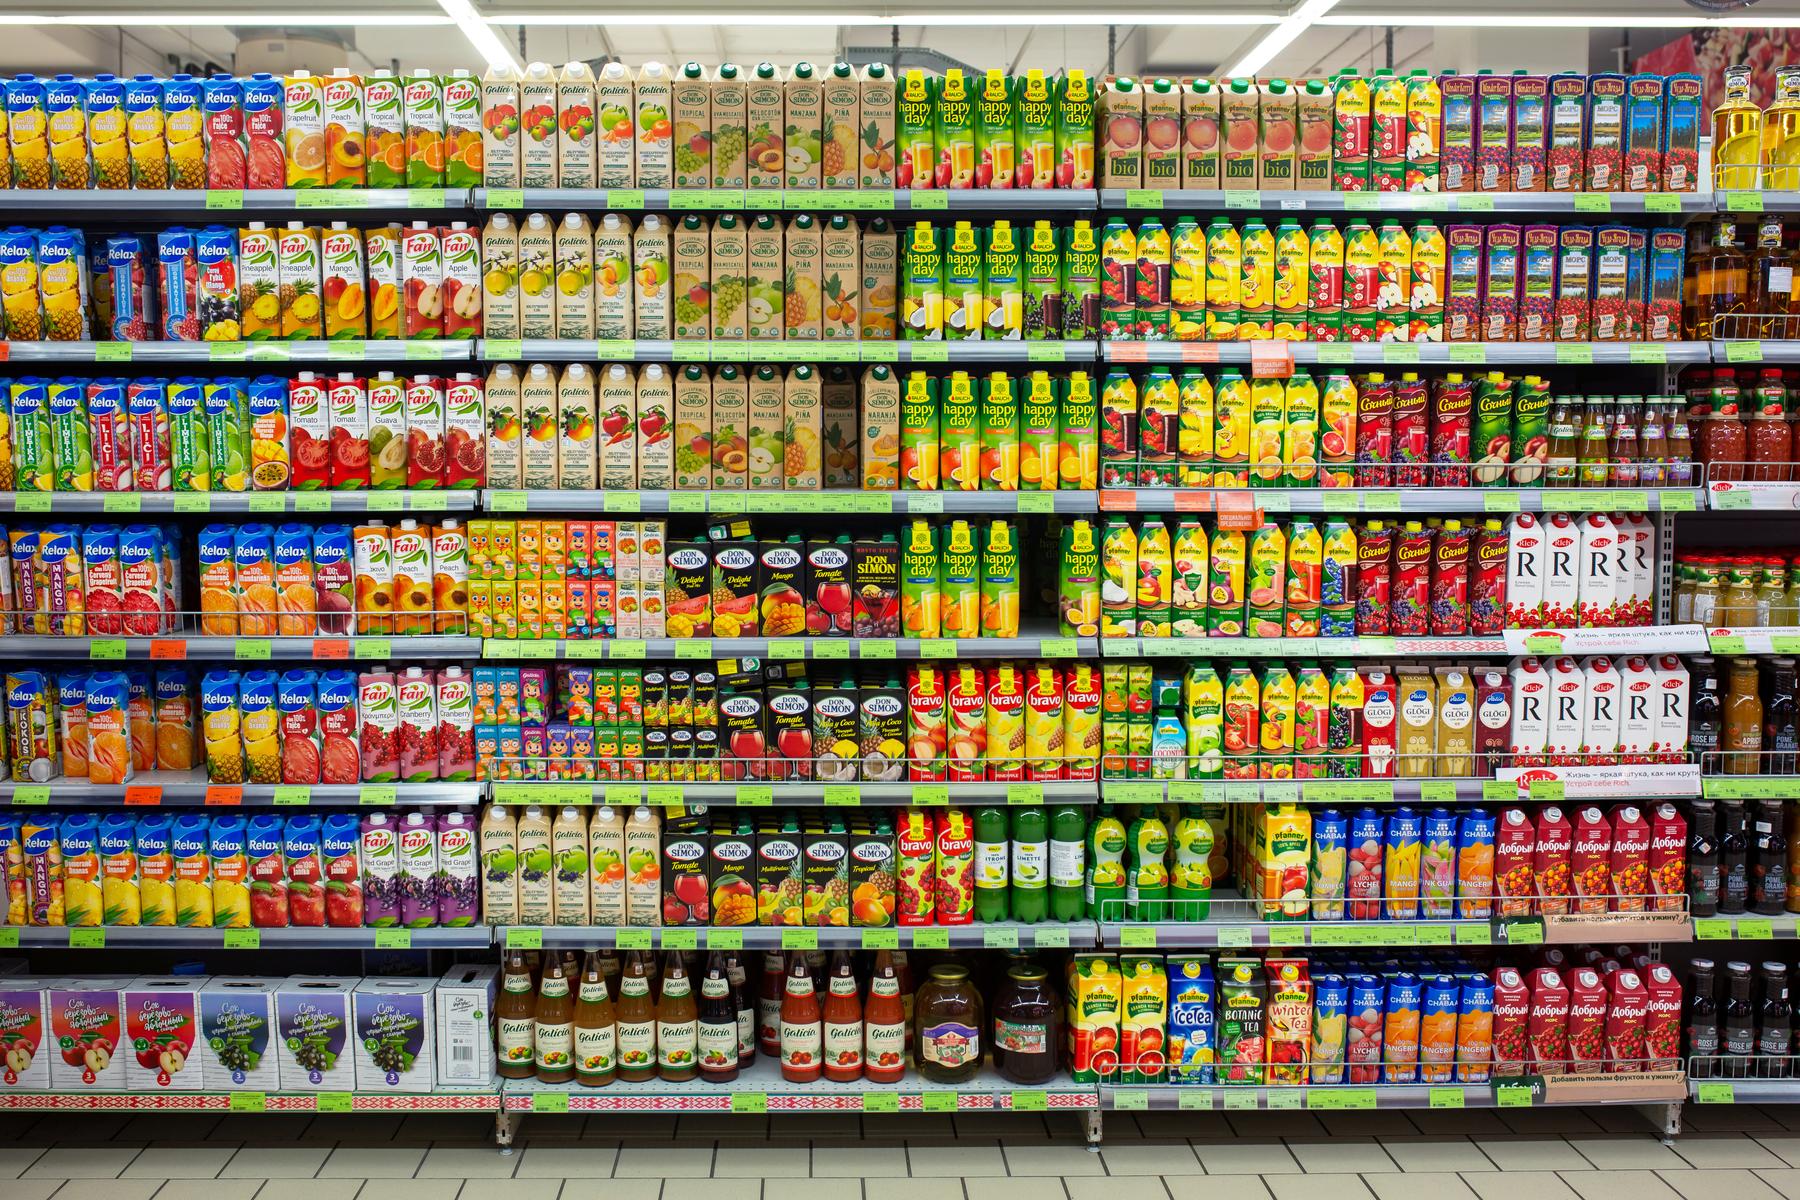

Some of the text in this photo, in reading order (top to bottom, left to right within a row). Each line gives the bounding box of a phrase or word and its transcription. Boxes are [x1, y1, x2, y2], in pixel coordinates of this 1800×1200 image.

[327, 86, 349, 100] Fan
[407, 86, 431, 100] Fan
[486, 86, 514, 95] Galicia
[639, 86, 669, 95] Galicia
[48, 93, 77, 104] Relax
[207, 93, 237, 103] Relax
[899, 101, 931, 114] happy
[1019, 101, 1052, 114] happy
[1341, 100, 1363, 108] pfanner
[371, 113, 394, 122] Tropical
[450, 113, 474, 121] Tropical
[905, 113, 927, 126] day
[1026, 113, 1047, 126] day
[1113, 161, 1136, 175] bio
[1266, 161, 1289, 177] bio
[241, 241, 265, 253] Fan
[406, 240, 431, 252] Fan
[637, 239, 665, 248] Galicia
[200, 245, 229, 254] Relax
[907, 253, 941, 266] happy
[1025, 253, 1059, 266] happy
[329, 265, 352, 273] Mango
[412, 265, 432, 273] Apple
[913, 264, 935, 277] day
[1032, 264, 1054, 277] day
[291, 391, 315, 404] Fan
[372, 391, 397, 404] Fan
[524, 388, 553, 397] Galicia
[604, 388, 632, 397] Galicia
[14, 397, 42, 406] Relax
[131, 397, 160, 407] Relax
[1394, 395, 1426, 411] Сочный
[1518, 398, 1549, 411] Сочный
[944, 405, 976, 418] happy
[1063, 405, 1096, 417] happy
[950, 416, 971, 428] day
[1070, 416, 1091, 428] day
[1713, 483, 1730, 491] Rich
[42, 545, 70, 555] Relax
[86, 545, 115, 556] Relax
[394, 540, 417, 552] Fan
[1359, 543, 1390, 558] Сочный
[1399, 544, 1431, 560] Сочный
[674, 556, 703, 565] SIMON
[768, 556, 797, 565] SIMON
[866, 556, 887, 564] DON
[944, 552, 976, 566] happy
[1066, 552, 1098, 565] happy
[1517, 552, 1536, 576] R
[1591, 551, 1610, 576] R
[815, 570, 842, 578] Tomate
[858, 564, 896, 574] SIMON
[950, 564, 972, 577] day
[1072, 563, 1094, 577] day
[52, 565, 63, 605] MANGO
[681, 576, 704, 584] Delight
[9, 691, 35, 701] Relax
[321, 693, 349, 704] Relax
[362, 687, 386, 700] Fan
[828, 698, 844, 706] DON
[912, 694, 942, 707] bravo
[1031, 694, 1060, 706] bravo
[727, 705, 756, 714] SIMON
[822, 705, 851, 714] SIMON
[1523, 697, 1542, 721] R
[1630, 696, 1649, 720] R
[400, 711, 431, 719] Cranberry
[441, 711, 471, 719] Cranberry
[776, 715, 803, 724] Tomate
[19, 713, 29, 754] KOKOS
[1566, 771, 1591, 779] Жизнь
[1624, 771, 1648, 779] тука,
[364, 833, 388, 847] Fan
[485, 830, 513, 840] Galicia
[628, 831, 657, 840] Galicia
[25, 839, 52, 848] Relax
[174, 840, 202, 850] Relax
[901, 838, 932, 851] bravo
[1536, 840, 1570, 852] Добрый
[672, 849, 701, 857] SIMON
[672, 862, 698, 870] Tomate
[723, 864, 745, 872] Mango
[37, 857, 46, 896] MANGO
[624, 980, 644, 988] Galicia
[69, 999, 84, 1009] Сок
[1230, 998, 1260, 1006] pfanner
[377, 1003, 395, 1014] Сок
[1533, 1003, 1568, 1016] Добрый
[503, 1022, 535, 1032] Galicia
[1244, 1022, 1259, 1032] TEA
[1291, 1017, 1307, 1029] Tea
[619, 1027, 651, 1036] Galicia
[785, 1028, 816, 1038] Galicia
[1613, 1074, 1642, 1082] фруктов
[1651, 1073, 1679, 1081] ужину?
